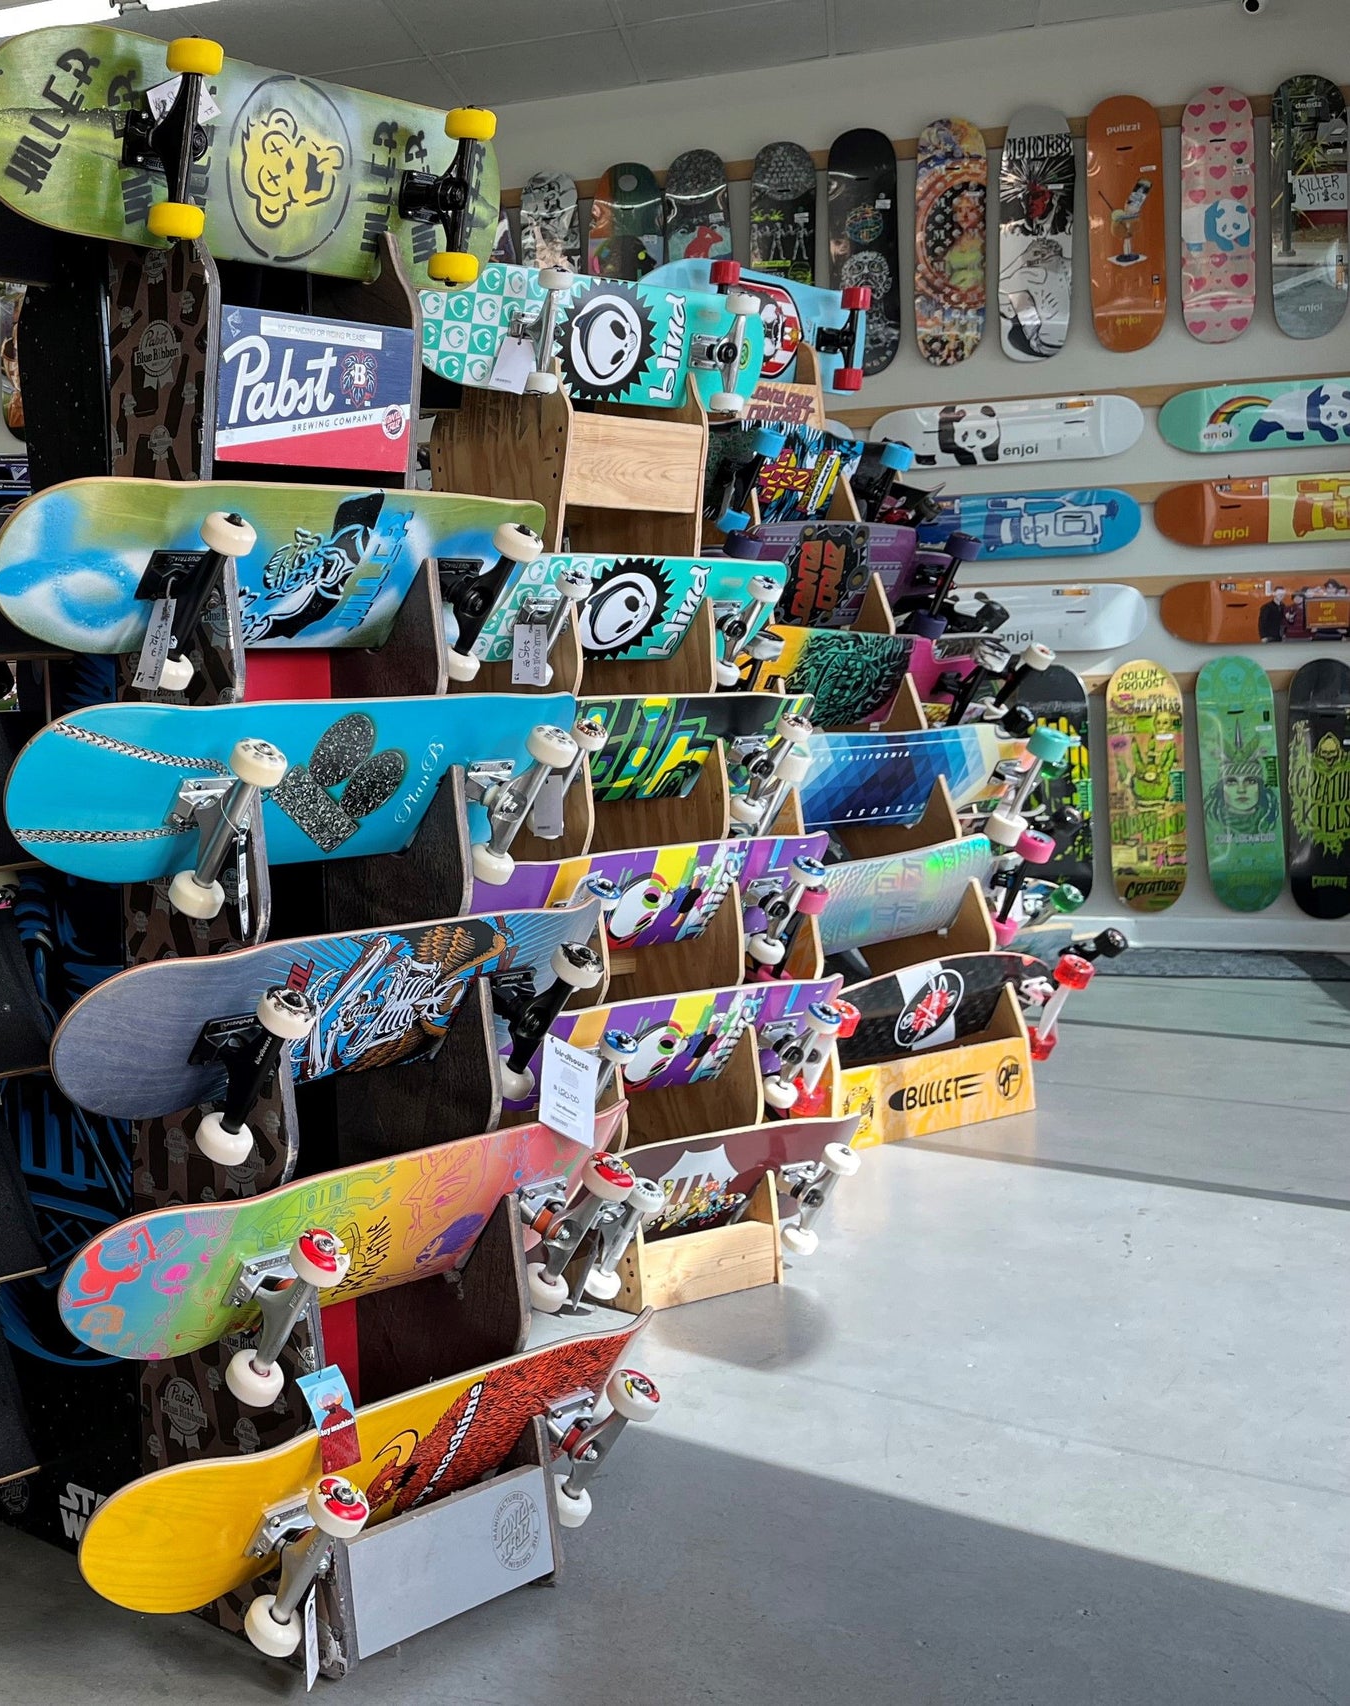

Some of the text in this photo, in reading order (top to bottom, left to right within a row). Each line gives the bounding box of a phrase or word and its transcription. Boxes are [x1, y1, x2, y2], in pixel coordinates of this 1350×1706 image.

[1006, 133, 1072, 160] MADNESS
[1298, 175, 1340, 195] KILLER
[145, 330, 168, 347] Pabst
[649, 292, 686, 400] blind
[136, 346, 179, 365] Blue Ribbon
[223, 335, 338, 424] Pabst
[291, 413, 373, 432] BREWING COMPANY
[1203, 428, 1233, 441] enjoi
[1002, 443, 1039, 457] enjoi
[1213, 525, 1250, 541] enjoi
[647, 564, 712, 655] blind
[1116, 677, 1167, 692] PROVOST
[1120, 669, 1158, 682] COLLIN
[840, 751, 910, 762] CALIFORNIA
[394, 735, 445, 823] Plan B
[1144, 815, 1186, 842] HAND
[1125, 880, 1182, 899] CREATURE
[254, 1036, 272, 1064] birdhouse
[554, 1046, 589, 1072] birdhouse
[906, 1075, 972, 1111] BULLET
[347, 1215, 392, 1291] MACHINE
[331, 1270, 360, 1297] TOY
[171, 1383, 195, 1407] Pabst
[163, 1401, 206, 1427] Blue Ribbon
[493, 1492, 524, 1542] MANUFACTURED
[529, 1503, 537, 1513] BY
[497, 1501, 530, 1543] SANTA
[502, 1522, 530, 1560] CRUZ
[530, 1530, 539, 1550] THE
